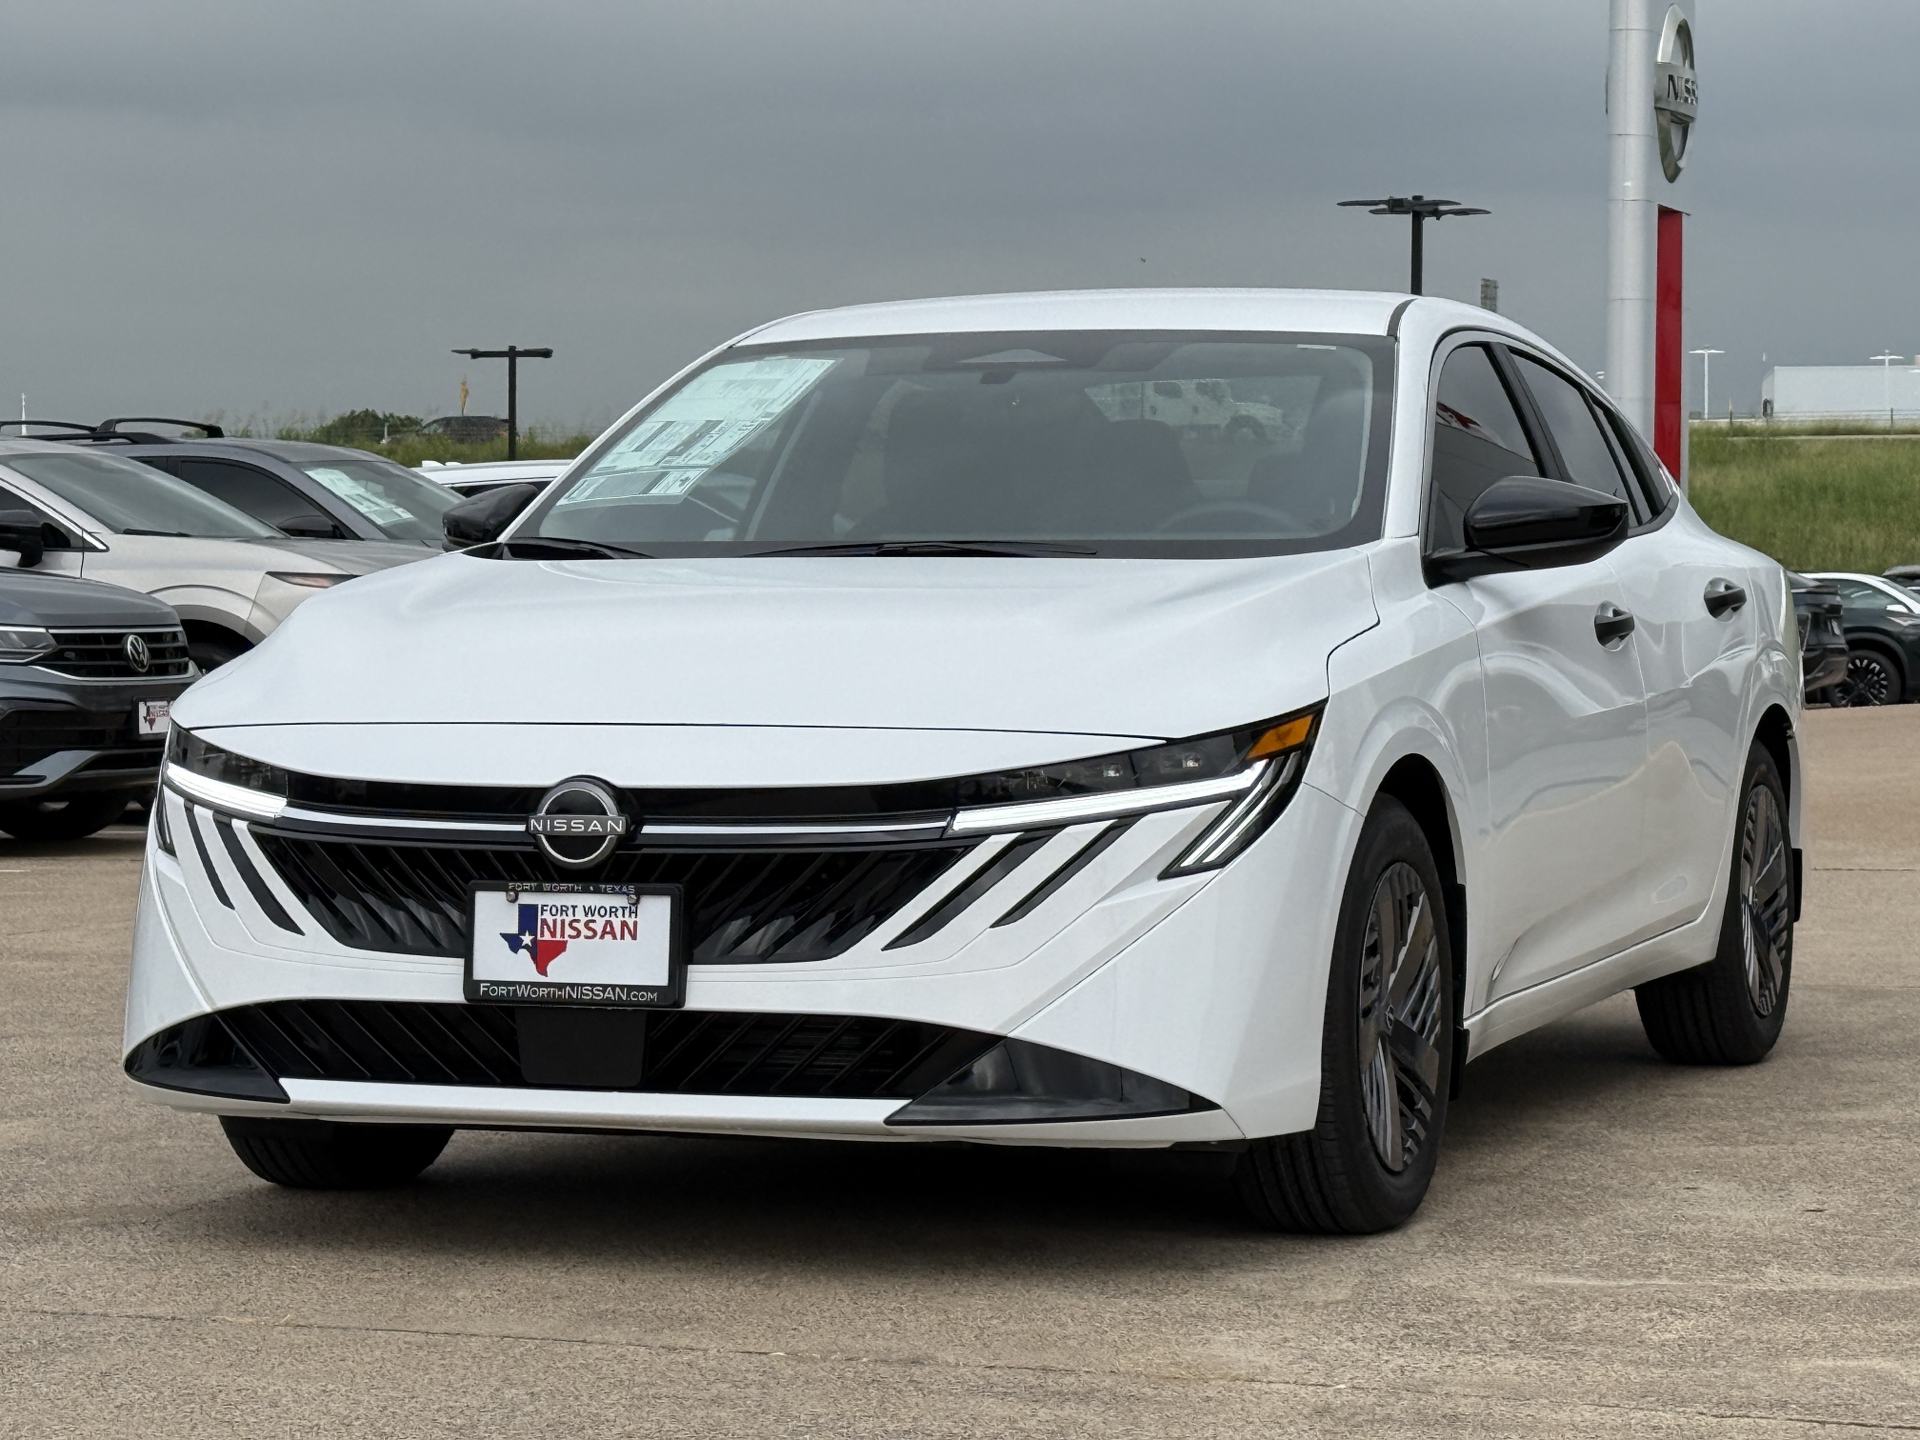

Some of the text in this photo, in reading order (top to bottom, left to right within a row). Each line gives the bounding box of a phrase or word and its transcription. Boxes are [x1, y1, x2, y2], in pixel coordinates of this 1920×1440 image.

[530, 818, 623, 832] NISSAN
[508, 882, 635, 893] FORT WORTH TEXAS
[540, 904, 638, 918] FORT WORTH
[539, 918, 638, 941] NISSAN
